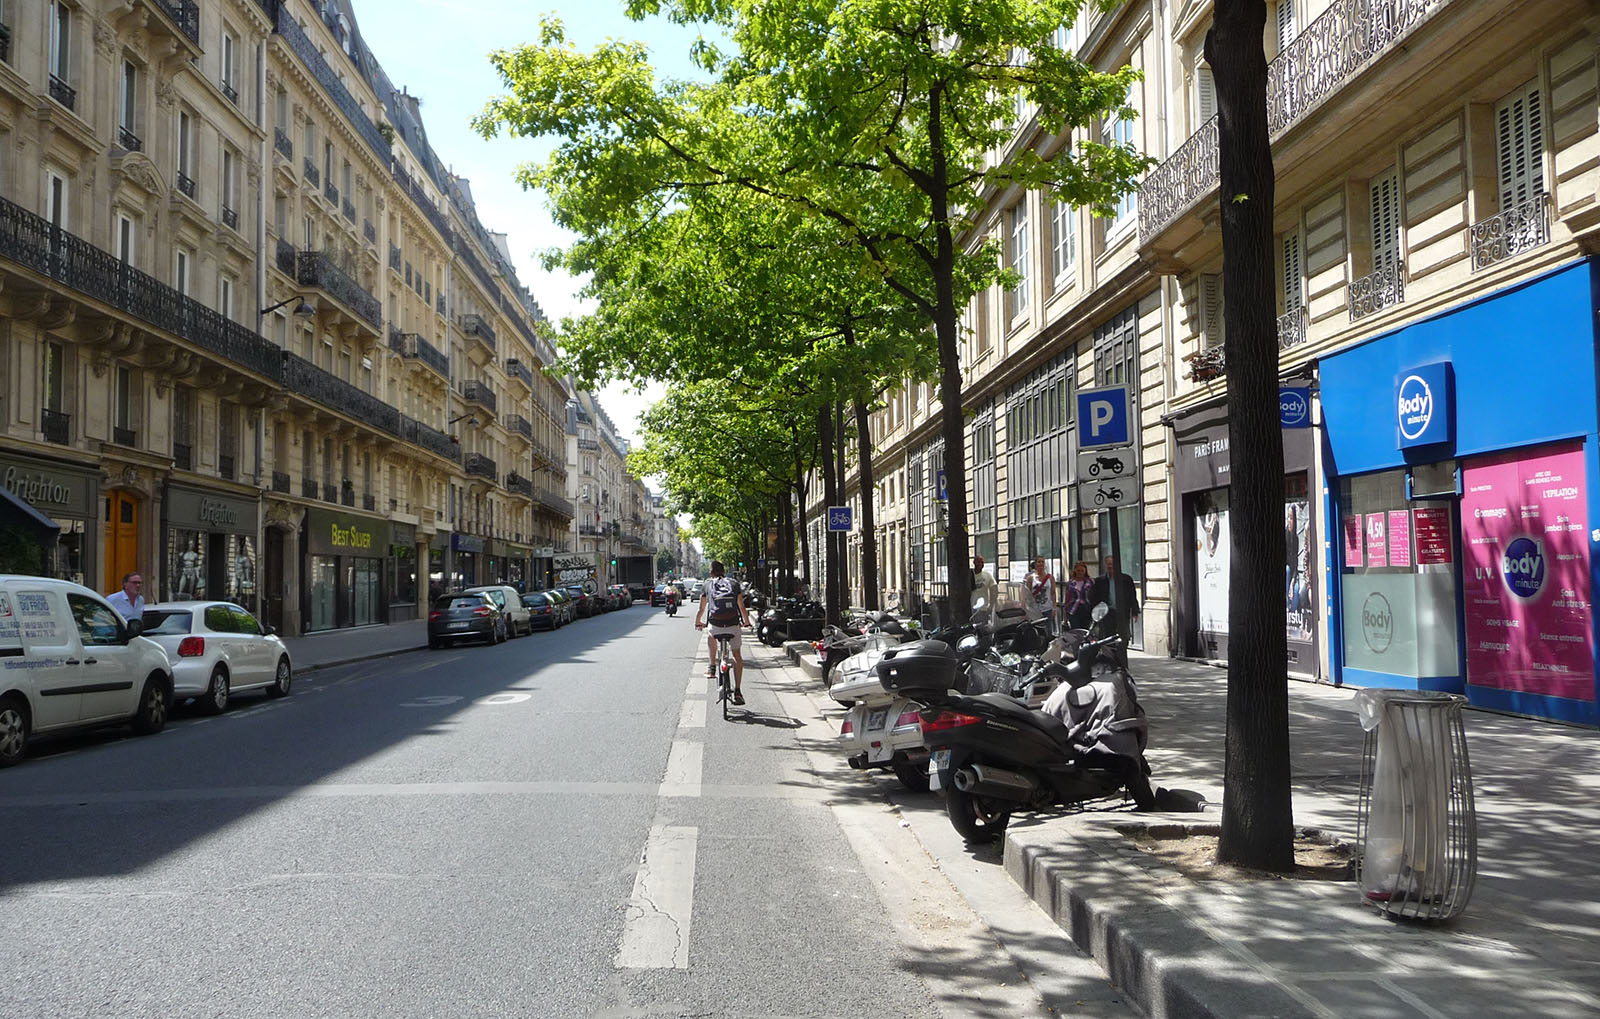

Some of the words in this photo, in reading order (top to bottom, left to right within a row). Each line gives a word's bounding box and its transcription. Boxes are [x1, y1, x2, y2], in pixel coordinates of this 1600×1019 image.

[1090, 400, 1114, 436] P
[1194, 442, 1211, 459] PARIS
[5, 466, 71, 504] Brighton
[200, 497, 239, 526] Brighton
[331, 523, 349, 546] BEST
[350, 526, 371, 548] SILVER
[1503, 552, 1540, 578] Body
[1515, 579, 1540, 590] minute
[1363, 611, 1390, 632] Body
